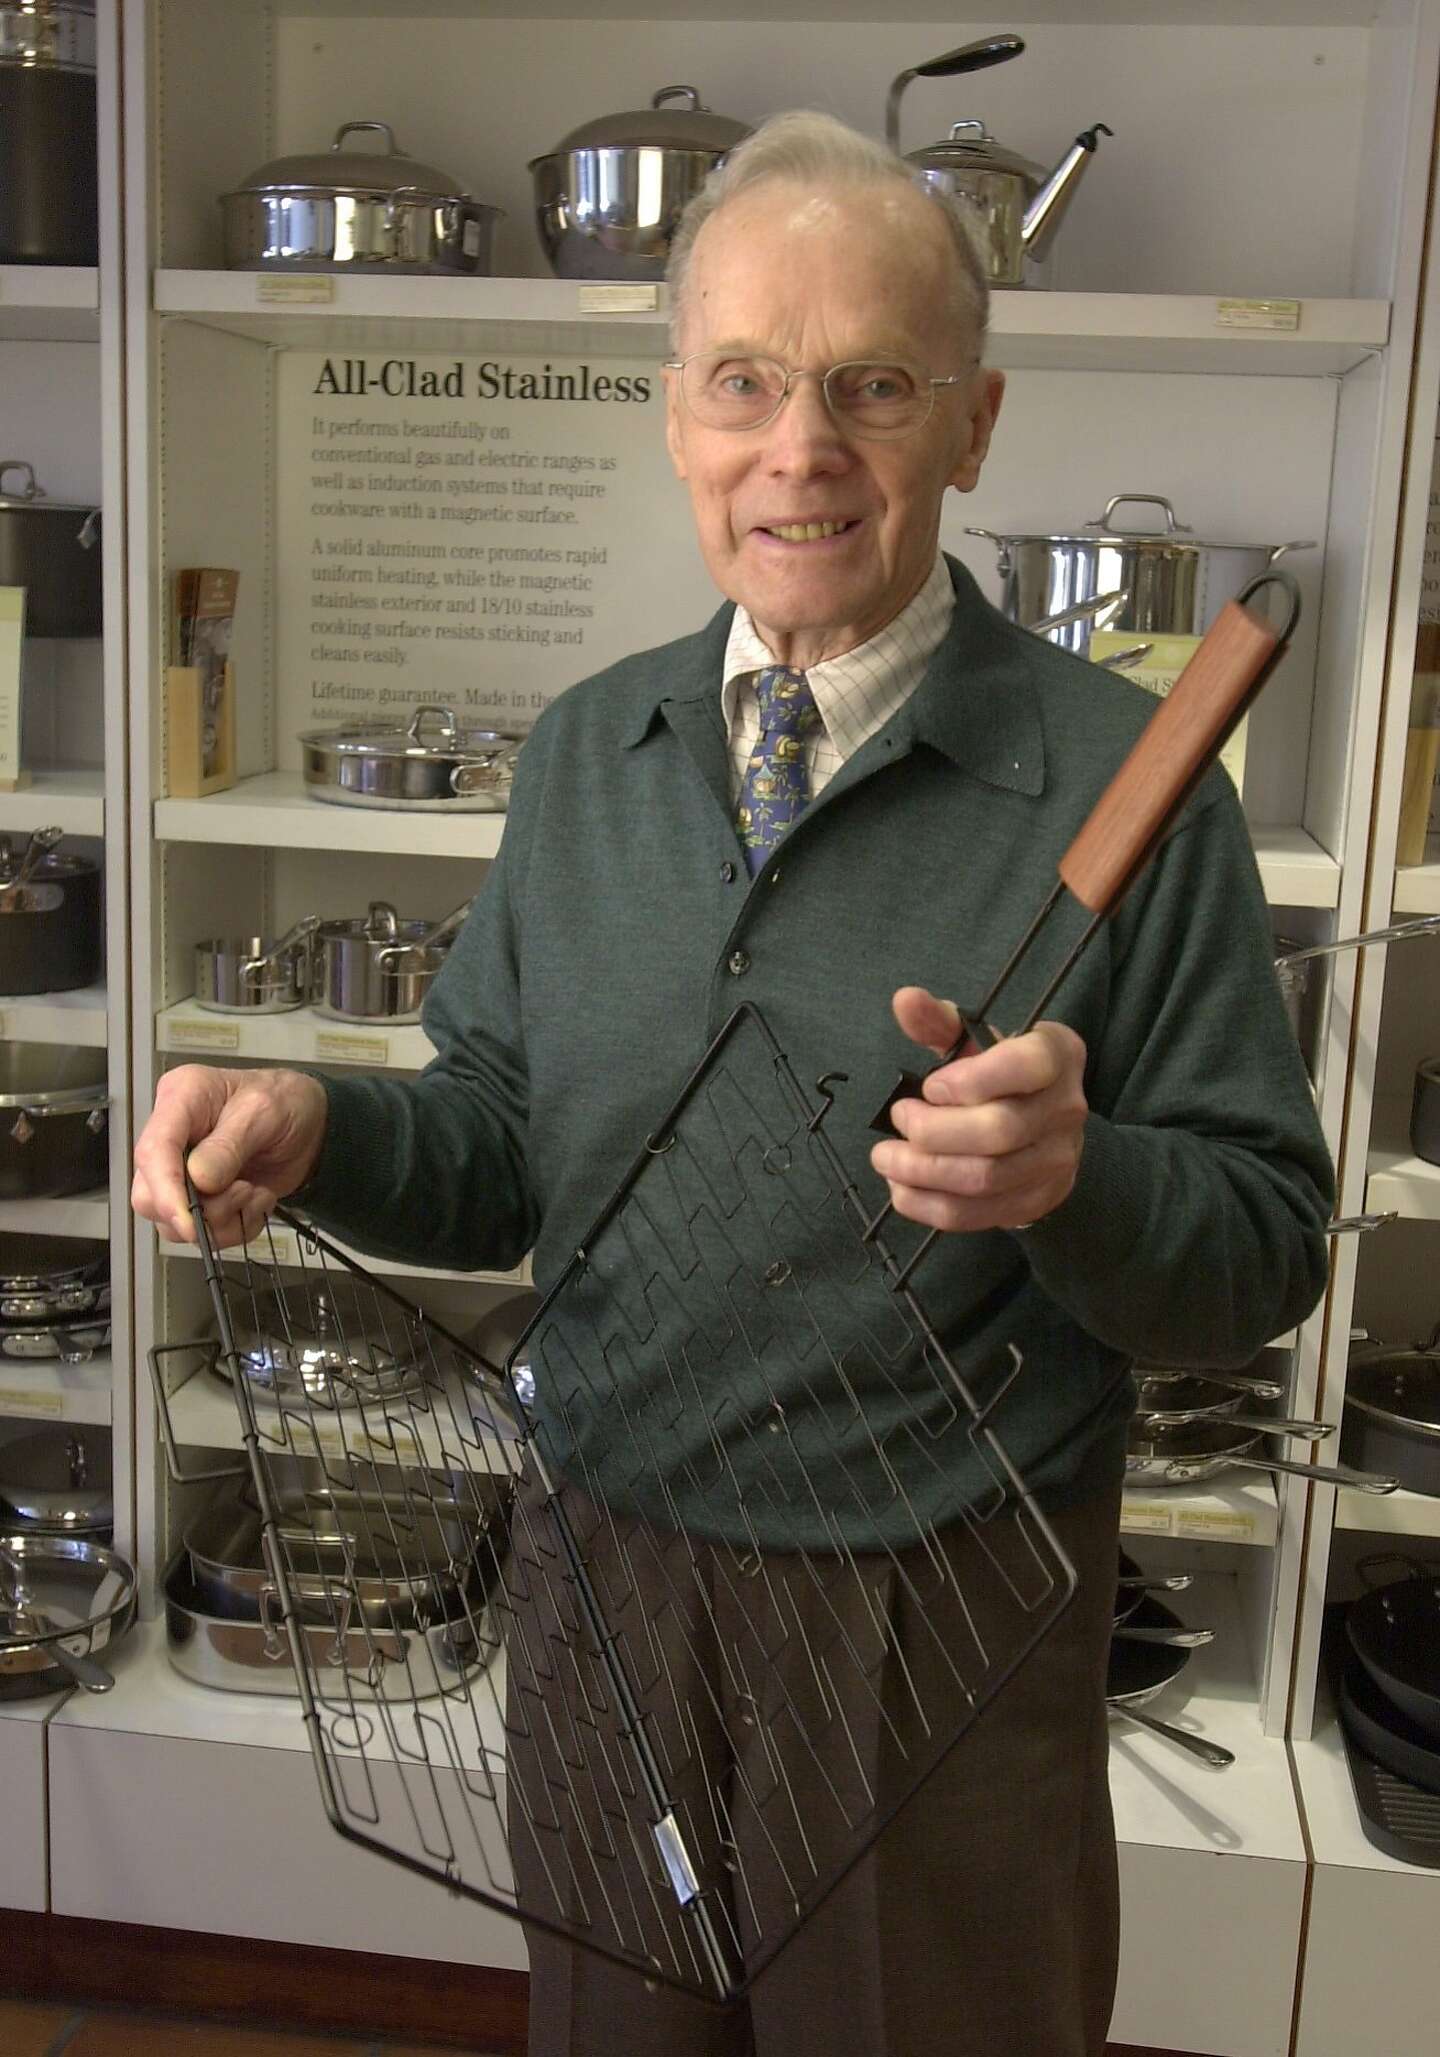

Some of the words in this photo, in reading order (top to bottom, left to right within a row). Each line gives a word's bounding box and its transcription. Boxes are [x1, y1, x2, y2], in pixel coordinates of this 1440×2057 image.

[313, 359, 464, 397] All-Clad
[479, 363, 651, 402] Stainless
[312, 417, 325, 434] It
[329, 418, 399, 441] performs
[403, 420, 486, 442] beautifully
[489, 424, 510, 440] on
[311, 448, 411, 465] conventional
[415, 451, 440, 469] gas
[444, 450, 475, 467] and
[478, 452, 538, 470] electric
[542, 455, 594, 474] ranges
[598, 457, 618, 471] as
[311, 474, 343, 492] well
[346, 477, 365, 491] as
[367, 475, 443, 493] induction
[446, 479, 508, 497] systems
[512, 480, 544, 496] that
[548, 482, 606, 501] require
[311, 501, 386, 519] cookware
[389, 503, 424, 520] with
[427, 507, 437, 520] a
[440, 505, 514, 525] magnetic
[517, 506, 579, 525] surface.
[311, 538, 324, 555] A
[327, 538, 363, 556] solid
[366, 540, 447, 558] aluminum
[450, 545, 485, 559] core
[488, 545, 562, 565] promotes
[566, 546, 608, 565] rapid
[311, 564, 373, 583] uniform
[443, 569, 486, 588] while
[489, 571, 516, 588] the
[519, 572, 593, 592] magnetic
[311, 591, 378, 609] stainless
[381, 593, 443, 612] exterior
[447, 595, 475, 613] and
[525, 599, 594, 618] stainless
[311, 619, 371, 639] cooking
[374, 619, 431, 638] surface
[435, 621, 484, 640] resists
[488, 623, 550, 645] sticking
[553, 627, 584, 645] and
[310, 645, 360, 662] cleans
[363, 648, 409, 667] easily.
[311, 681, 375, 700] Lifetime
[378, 685, 458, 706] guarantee.
[464, 688, 509, 706] Made
[511, 690, 526, 707] in
